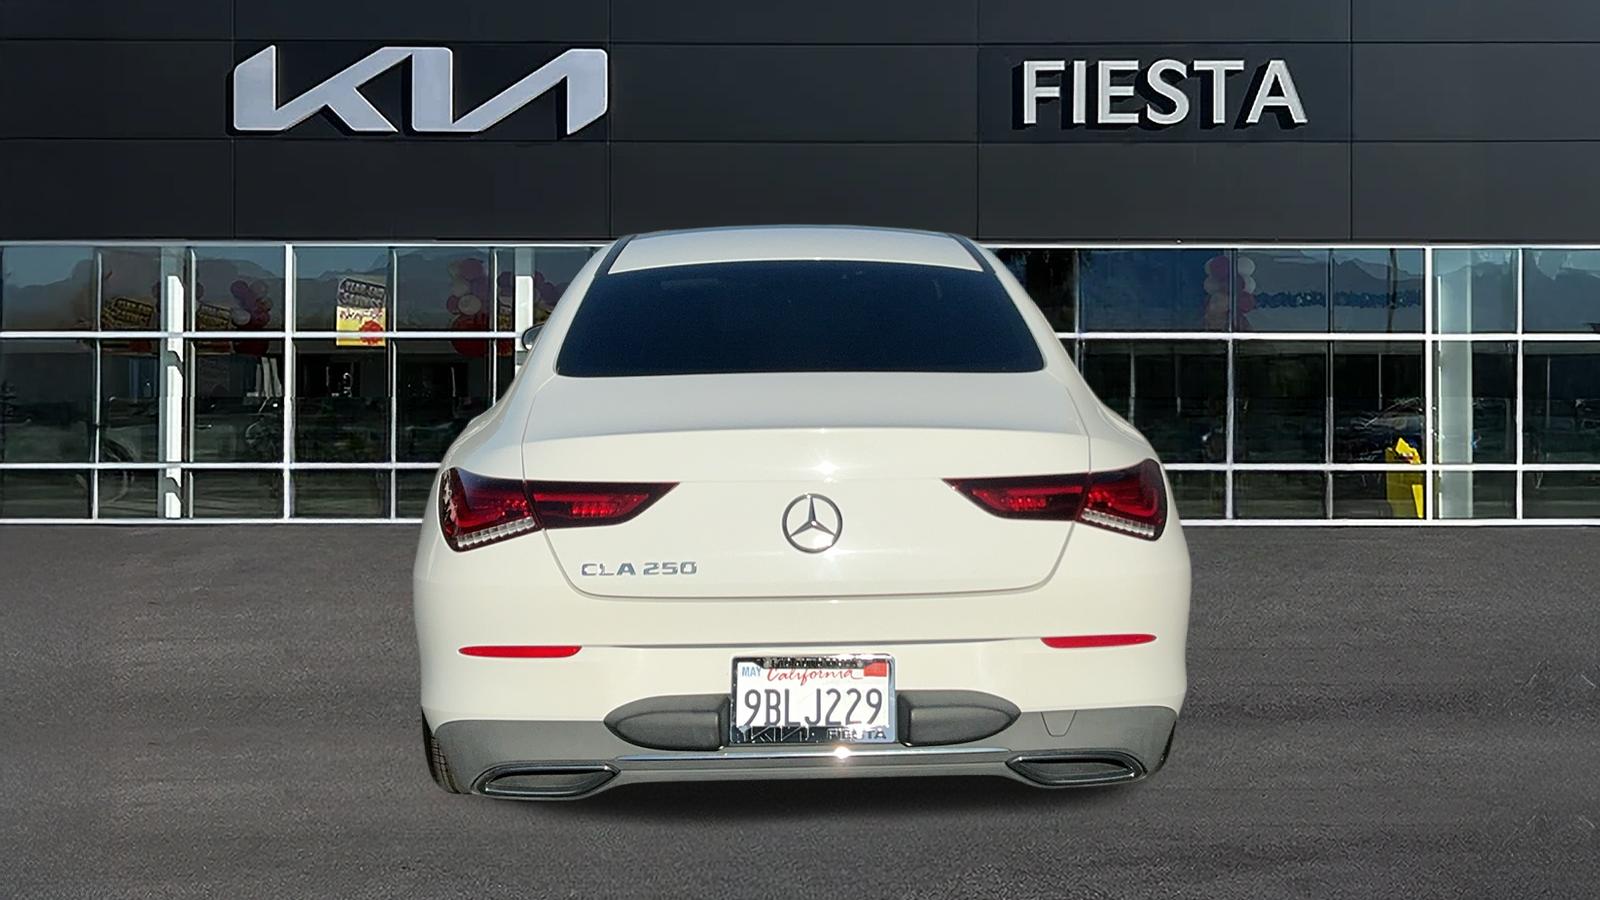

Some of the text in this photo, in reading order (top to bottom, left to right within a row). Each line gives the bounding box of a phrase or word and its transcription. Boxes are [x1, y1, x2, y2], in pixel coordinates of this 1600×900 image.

[1023, 59, 1308, 124] FIESTA
[581, 561, 697, 576] CLA 250
[741, 666, 761, 677] MAY
[767, 667, 863, 686] California
[744, 688, 883, 726] 9BLJ229
